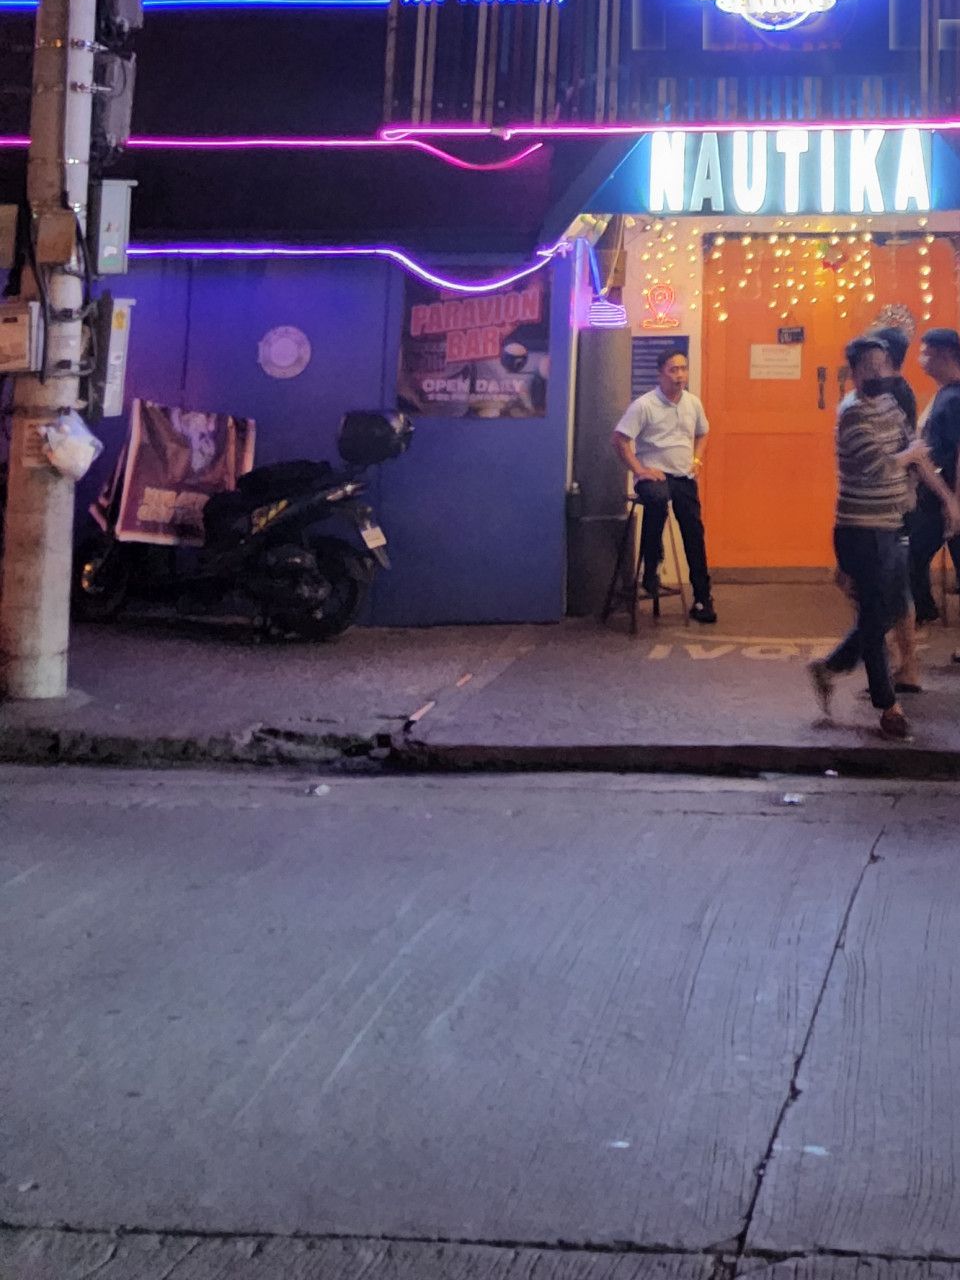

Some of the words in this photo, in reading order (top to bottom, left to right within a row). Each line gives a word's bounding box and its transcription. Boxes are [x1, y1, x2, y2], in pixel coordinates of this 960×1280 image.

[650, 127, 931, 213] NAUTIKA
[412, 287, 540, 337] PARAVION
[448, 326, 501, 362] BAR
[422, 377, 470, 394] OPEN
[475, 377, 526, 394] DAILY
